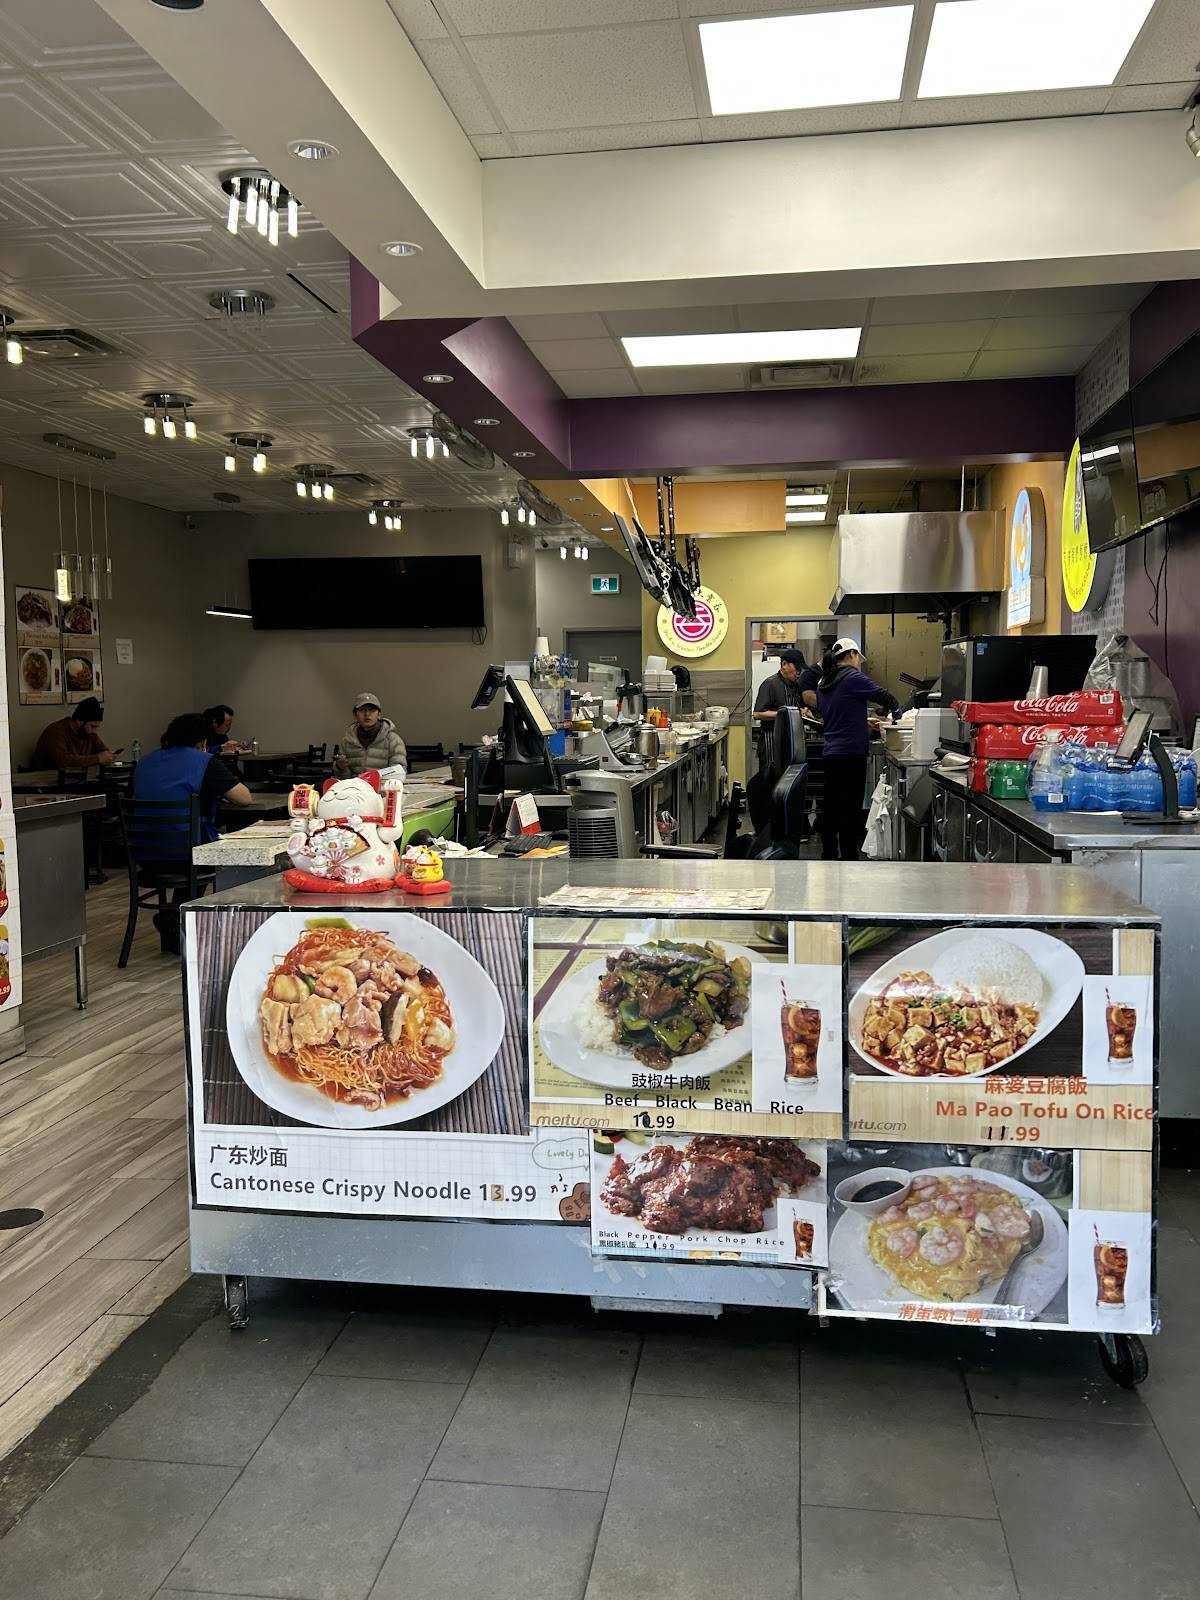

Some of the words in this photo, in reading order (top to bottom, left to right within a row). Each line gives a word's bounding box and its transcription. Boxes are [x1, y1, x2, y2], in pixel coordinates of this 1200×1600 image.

[631, 1073, 711, 1091] 豉椒牛肉飯
[604, 1093, 640, 1107] Beef
[655, 1095, 697, 1110] Black
[714, 1097, 753, 1113] Bean
[770, 1101, 804, 1115] Rice
[936, 1100, 967, 1117] Ma
[976, 1101, 1013, 1118] Pao
[1020, 1102, 1068, 1119] Tofu
[1075, 1103, 1105, 1120] On
[1113, 1103, 1153, 1121] Rice
[536, 1113, 610, 1128] meitu.com
[209, 1144, 288, 1168] 广东炒面
[210, 1172, 315, 1194] Cantonese
[322, 1178, 386, 1203] Crispy
[393, 1180, 471, 1201] Noodle
[479, 1183, 537, 1202] 13.99
[599, 1230, 619, 1239] Black
[627, 1231, 670, 1241] Pepper
[680, 1234, 708, 1243] Pork
[717, 1236, 747, 1245] Chop
[756, 1238, 785, 1246] Rice
